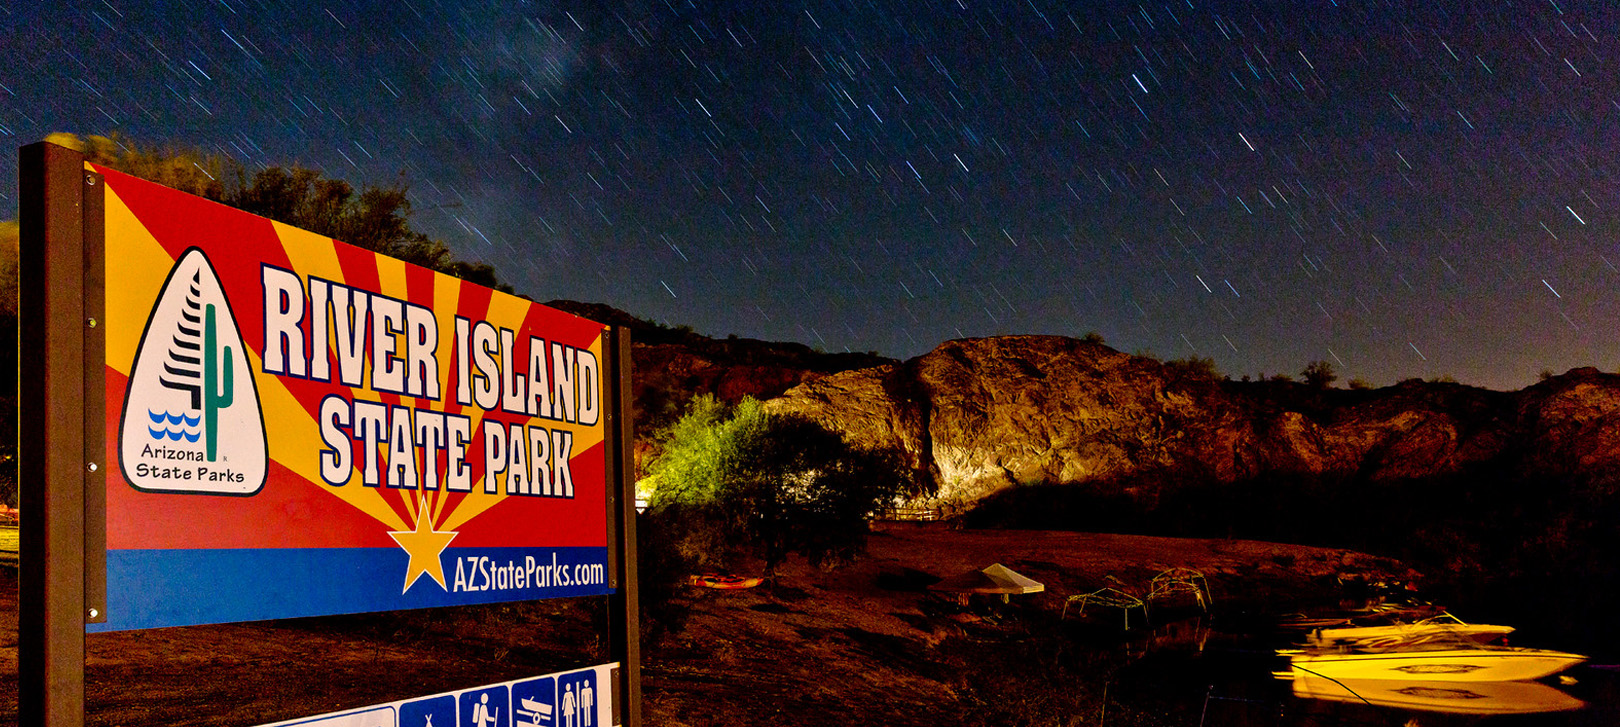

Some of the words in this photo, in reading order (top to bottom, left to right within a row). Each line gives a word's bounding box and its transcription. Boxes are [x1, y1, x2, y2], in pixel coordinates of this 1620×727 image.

[260, 262, 441, 401] RIVER
[454, 314, 600, 427] ISLAND
[141, 443, 204, 462] Arizona
[319, 393, 473, 493] STATE
[483, 418, 575, 499] PARK
[136, 463, 192, 480] State
[197, 467, 245, 483] Parks
[453, 552, 604, 593] AZStateParks.com
